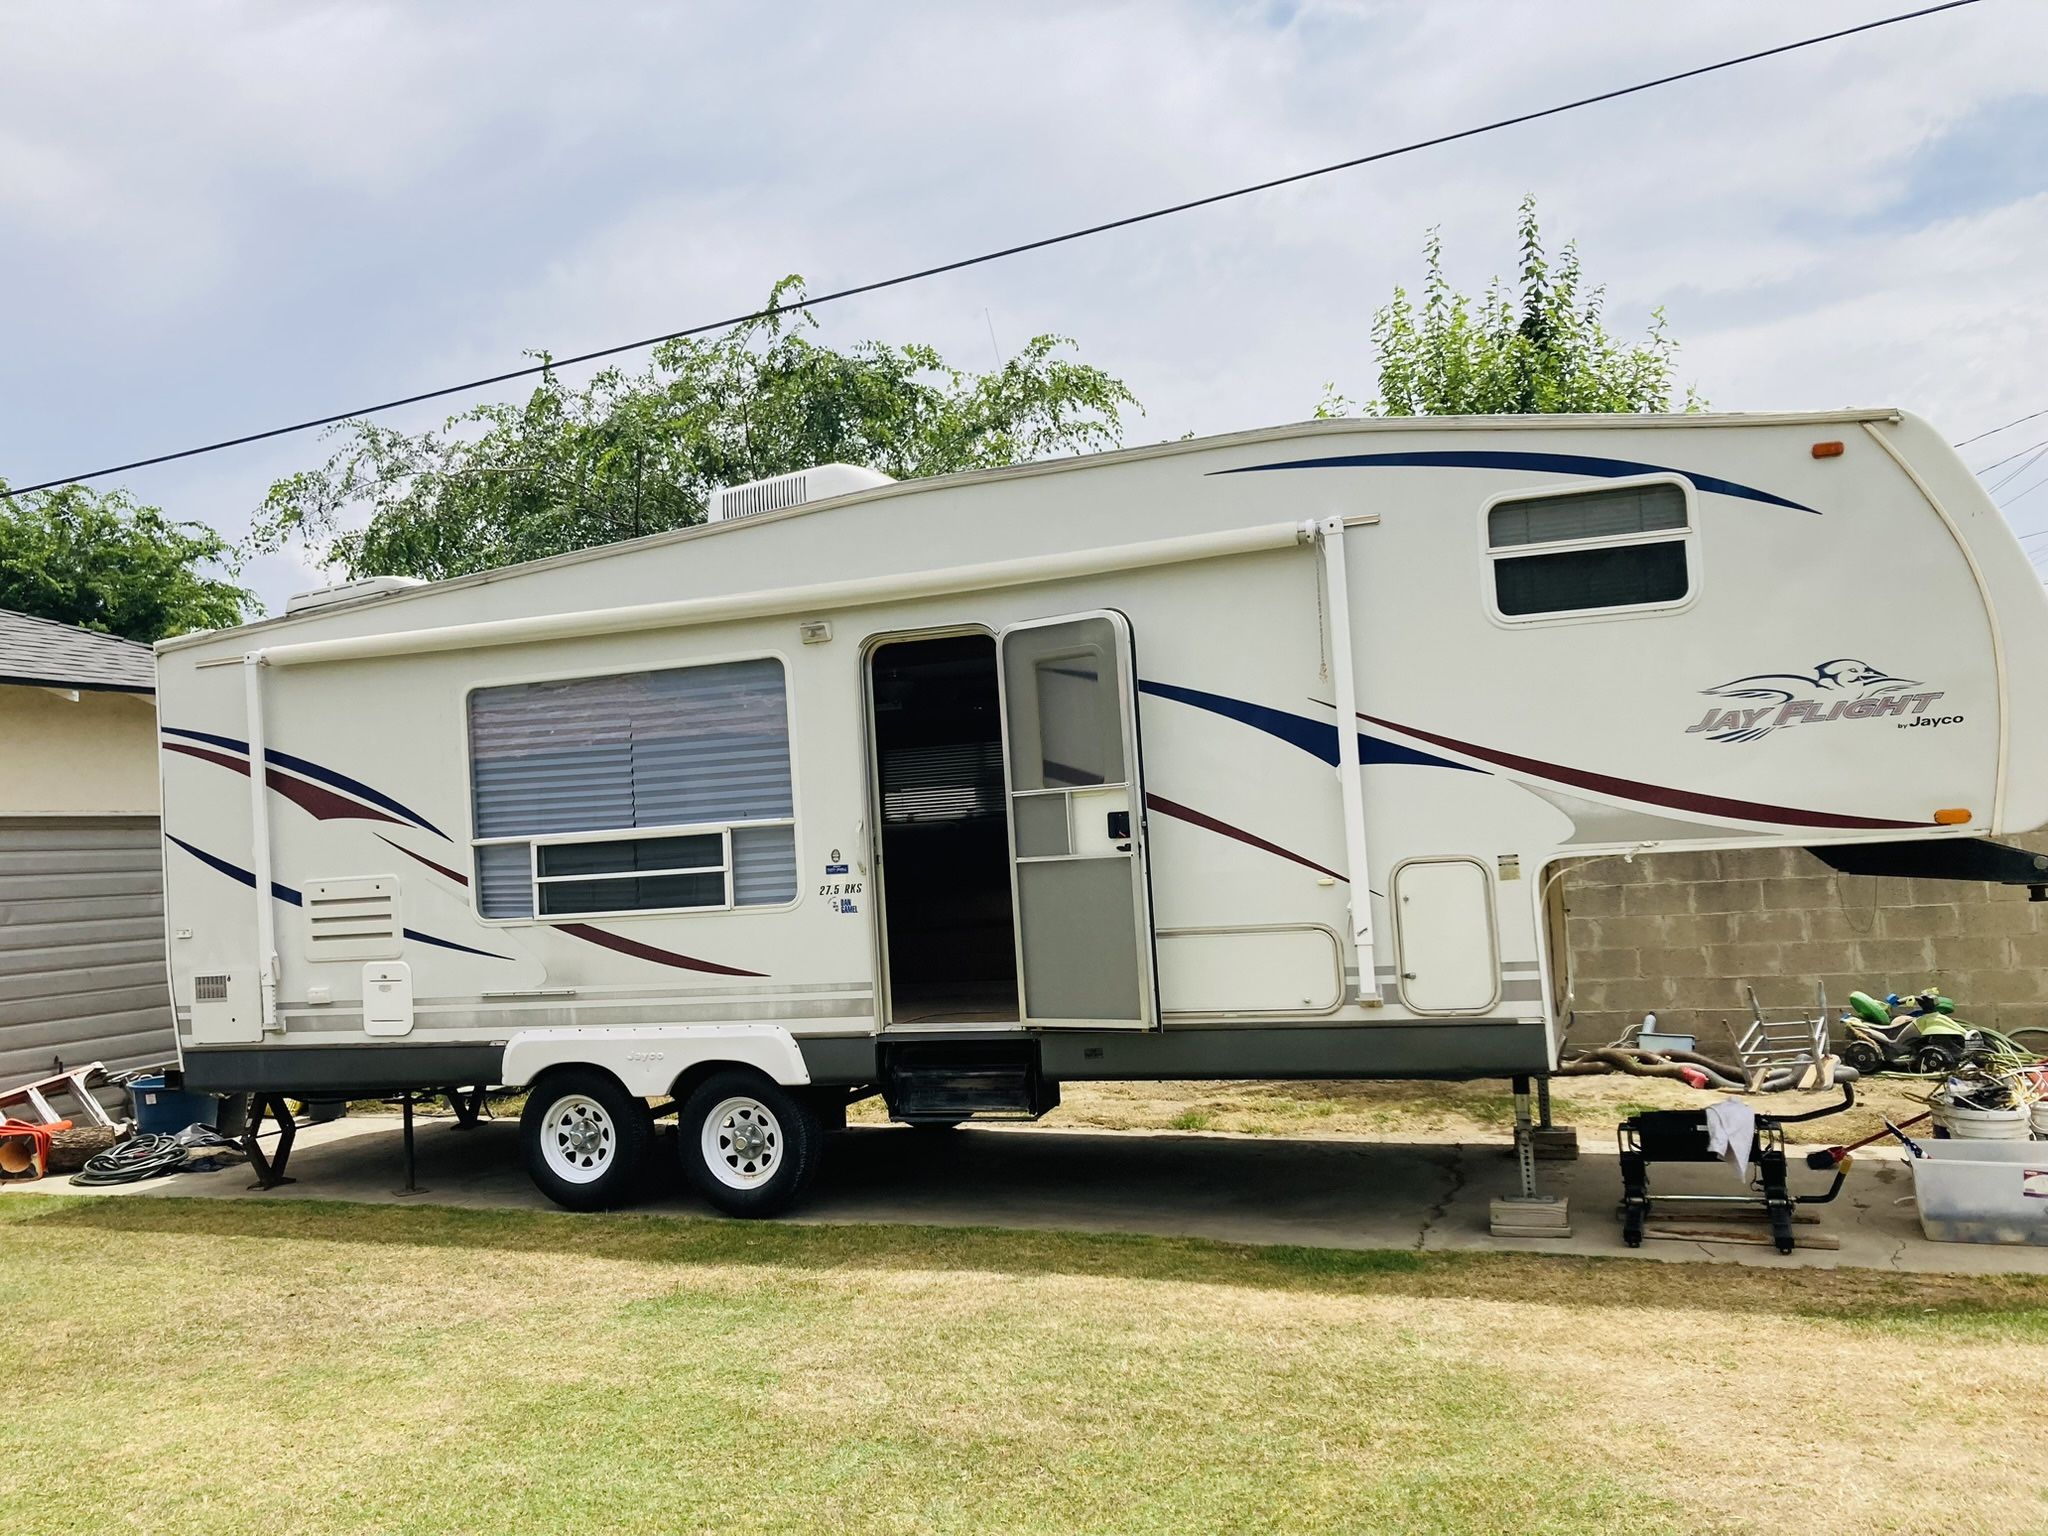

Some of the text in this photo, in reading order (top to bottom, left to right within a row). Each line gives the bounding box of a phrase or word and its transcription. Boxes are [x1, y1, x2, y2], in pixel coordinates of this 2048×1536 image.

[1685, 692, 1945, 733] JAY FLIGHT
[1909, 714, 1964, 728] Jayco
[819, 883, 862, 895] 27.5 RKS
[626, 1050, 664, 1062] Jayco
